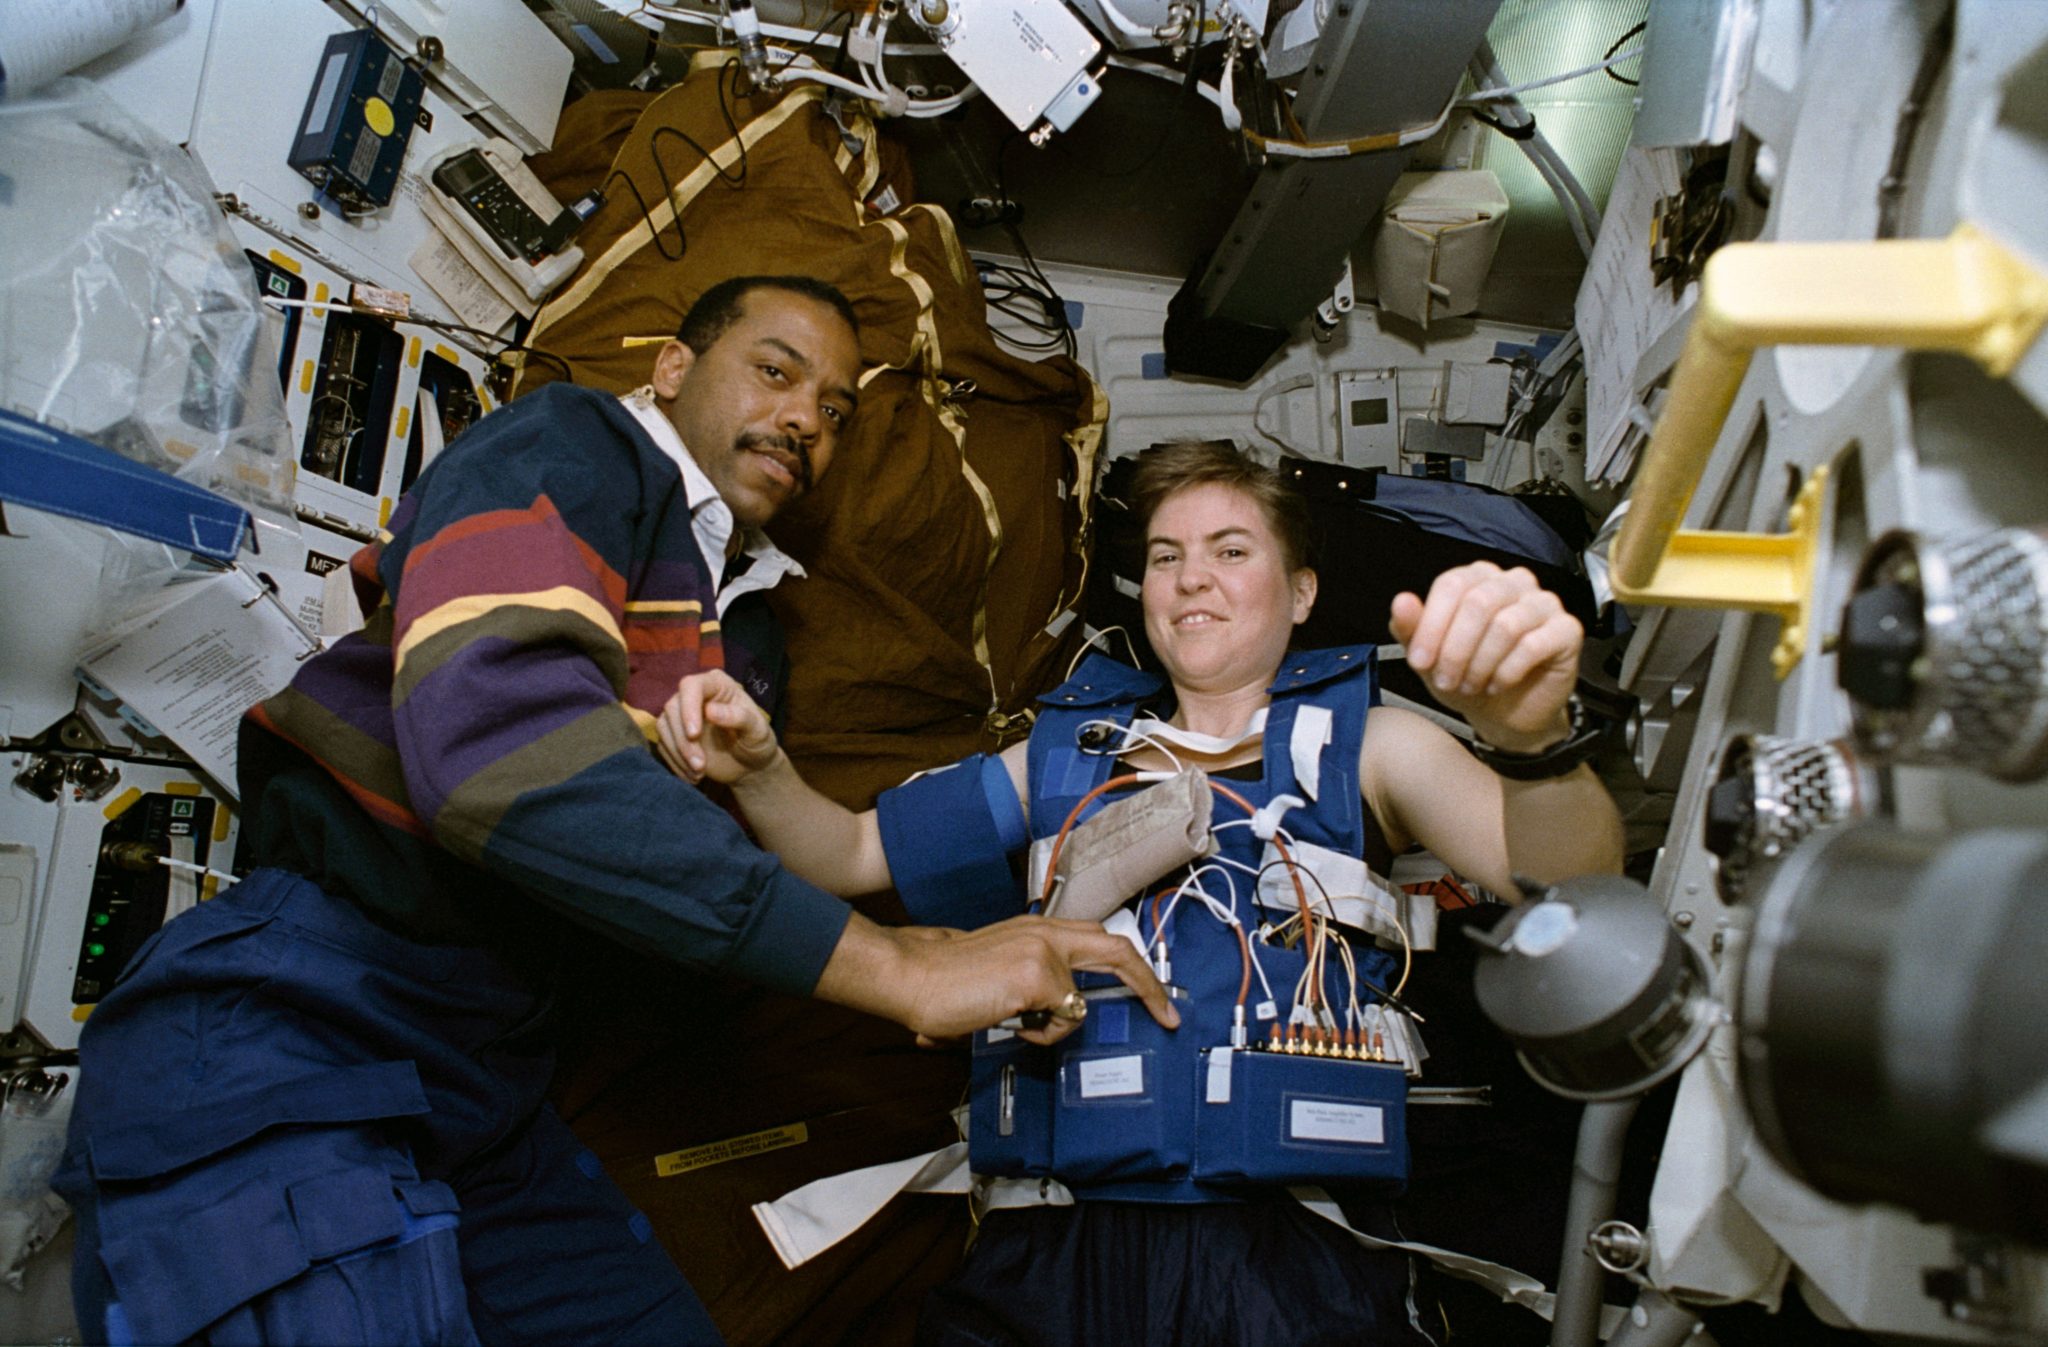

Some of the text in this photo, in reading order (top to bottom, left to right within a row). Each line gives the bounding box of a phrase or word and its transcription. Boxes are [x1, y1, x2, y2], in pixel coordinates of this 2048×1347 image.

[419, 111, 429, 127] C
[310, 556, 339, 572] MF7
[679, 1130, 785, 1161] REMOVE ALL STOWED ITEMS
[670, 1159, 692, 1172] FROM
[694, 1151, 730, 1166] POCKETS
[731, 1143, 763, 1157] BEFORE
